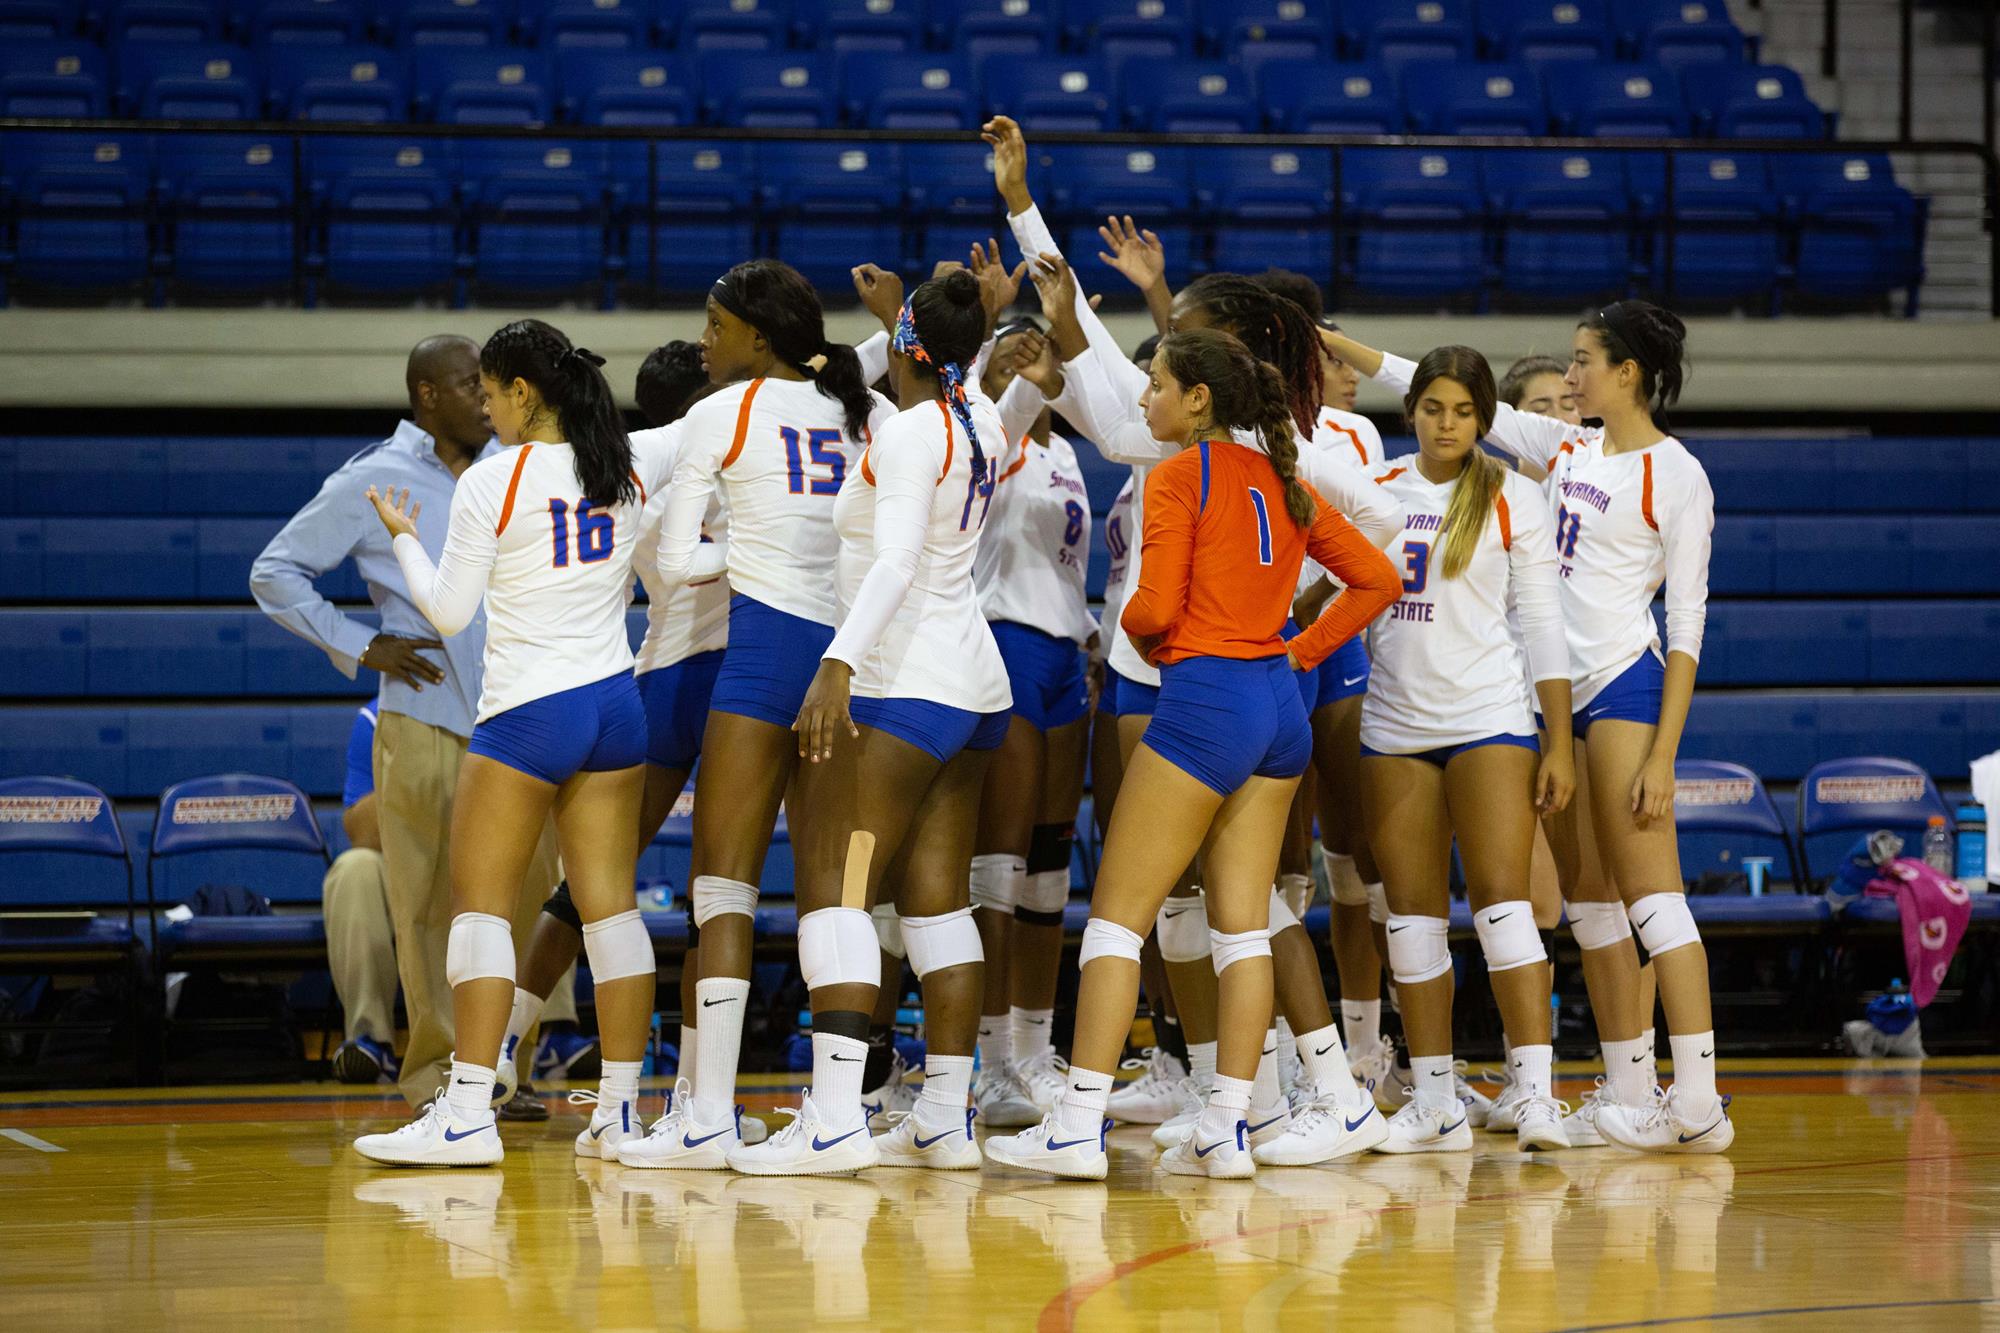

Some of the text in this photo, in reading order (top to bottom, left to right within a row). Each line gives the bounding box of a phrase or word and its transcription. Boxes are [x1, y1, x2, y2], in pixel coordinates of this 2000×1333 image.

[779, 425, 847, 496] 15
[549, 497, 615, 569] 16
[1064, 498, 1084, 547] 8
[1248, 486, 1273, 566] 1
[1401, 540, 1430, 595] 3
[1391, 601, 1435, 622] STATE
